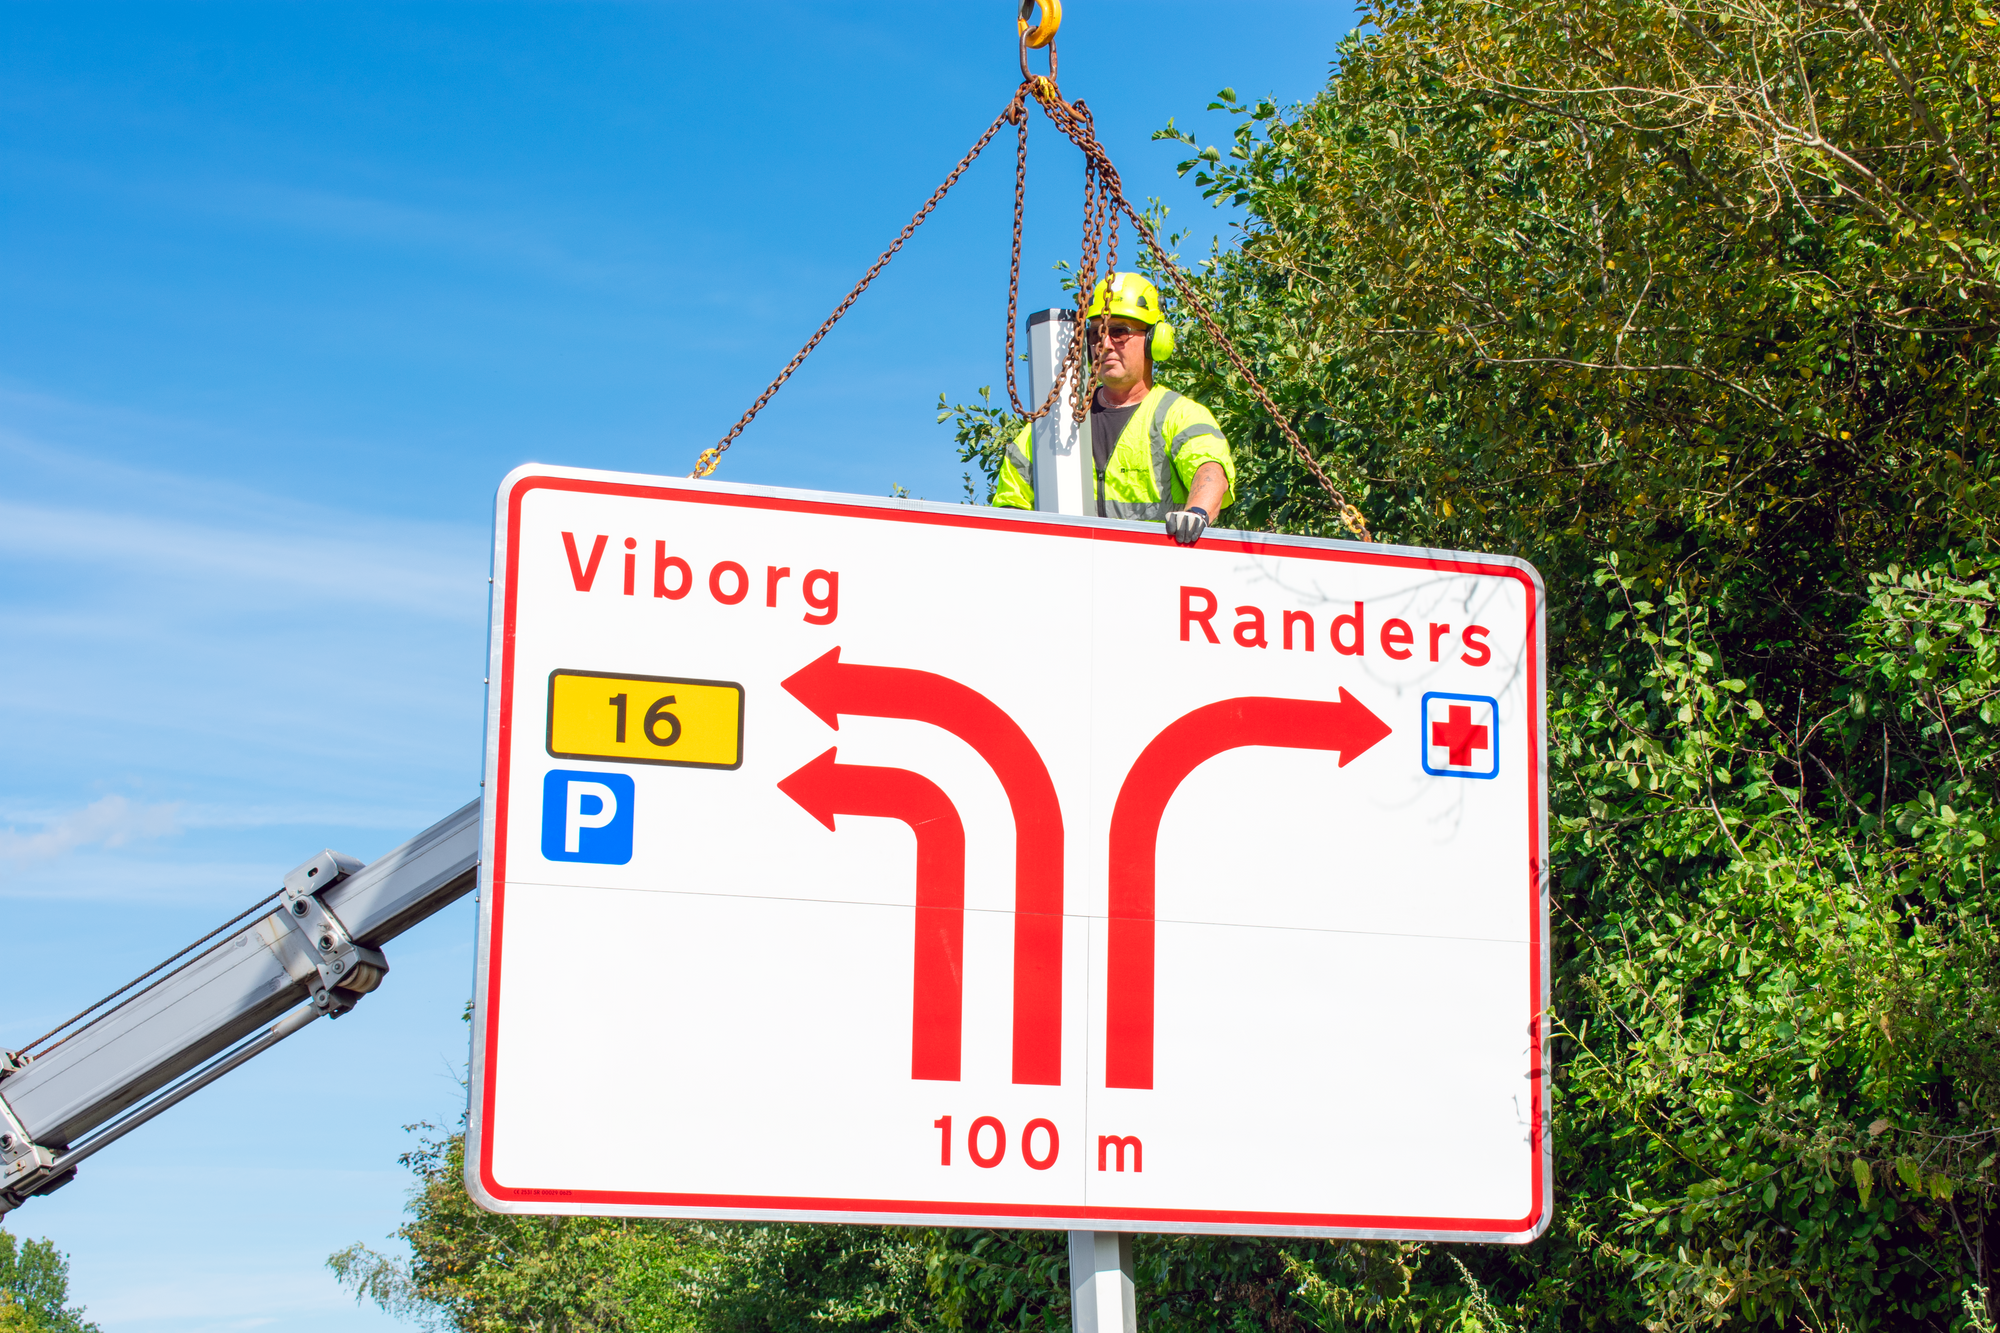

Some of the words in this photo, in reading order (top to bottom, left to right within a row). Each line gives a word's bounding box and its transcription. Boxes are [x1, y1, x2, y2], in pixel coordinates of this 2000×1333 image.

[561, 531, 839, 626] Viborg
[1179, 585, 1492, 667] Randers
[608, 692, 682, 747] 16
[564, 780, 617, 853] P
[933, 1115, 1060, 1171] 100
[1097, 1134, 1143, 1173] m
